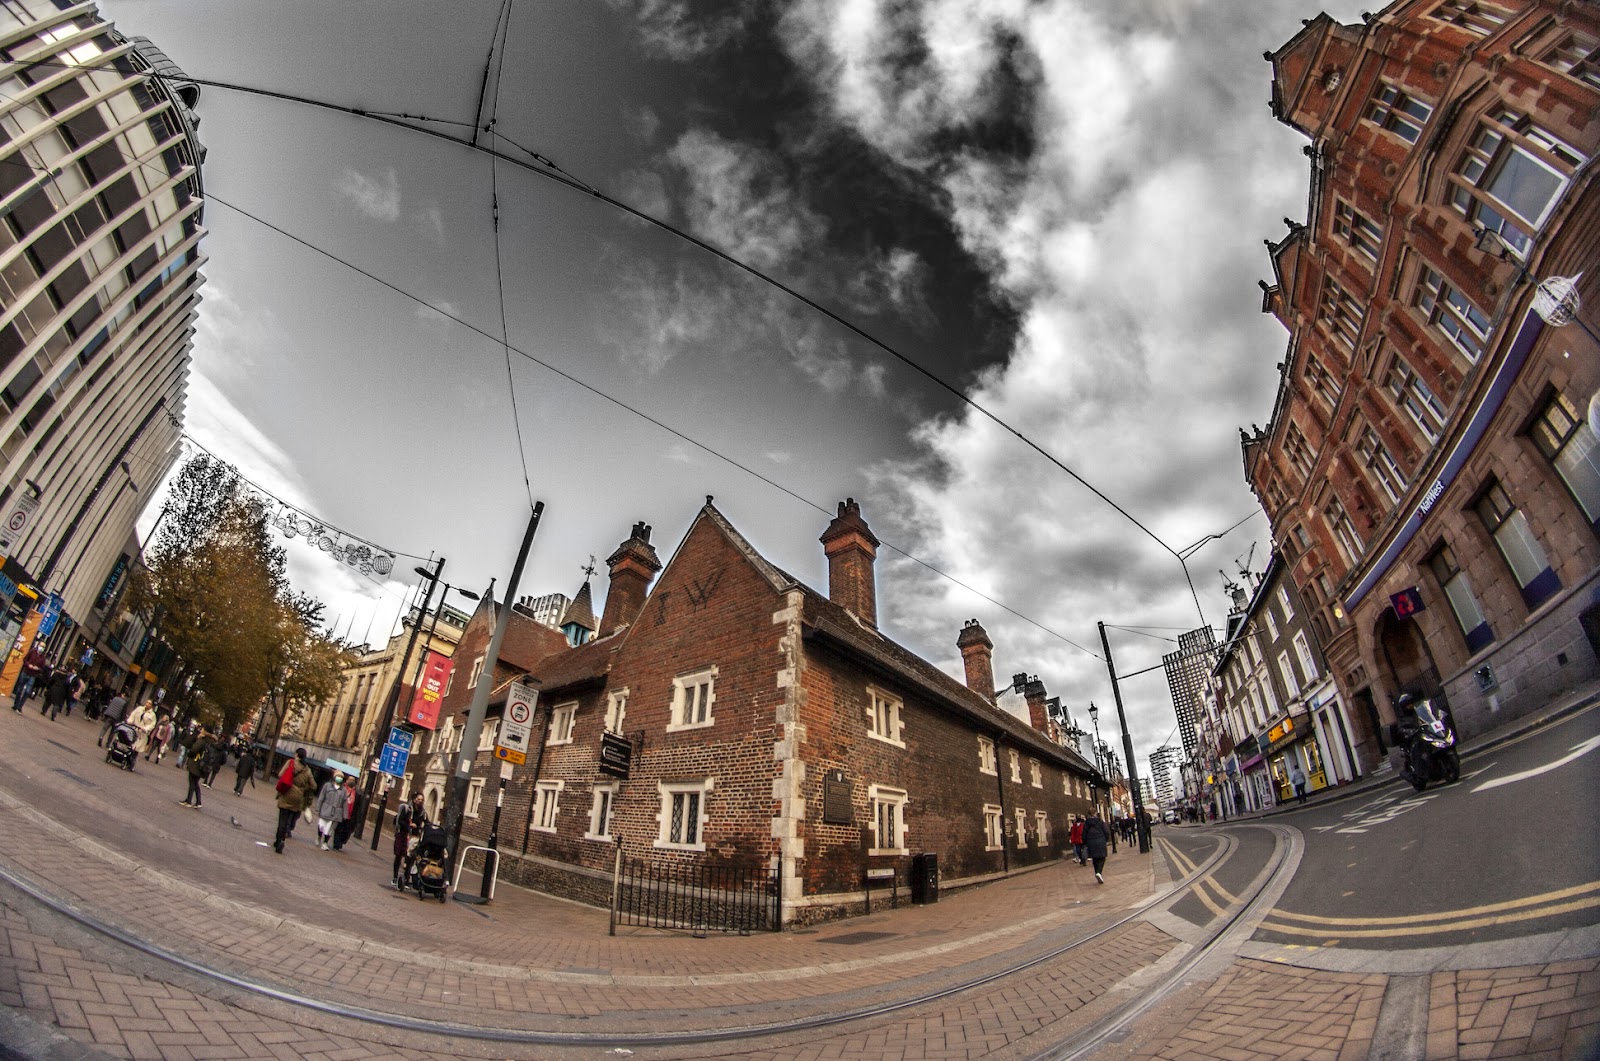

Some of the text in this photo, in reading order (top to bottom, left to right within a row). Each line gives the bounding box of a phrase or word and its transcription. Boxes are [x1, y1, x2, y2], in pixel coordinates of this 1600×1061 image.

[1420, 480, 1444, 514] NatWest
[18, 504, 32, 514] ZONE
[101, 562, 125, 600] PRIMARK
[428, 678, 440, 686] POP
[427, 684, 440, 692] OUT
[422, 688, 440, 699] WORK
[424, 694, 436, 703] OUT
[514, 692, 532, 704] ZONE
